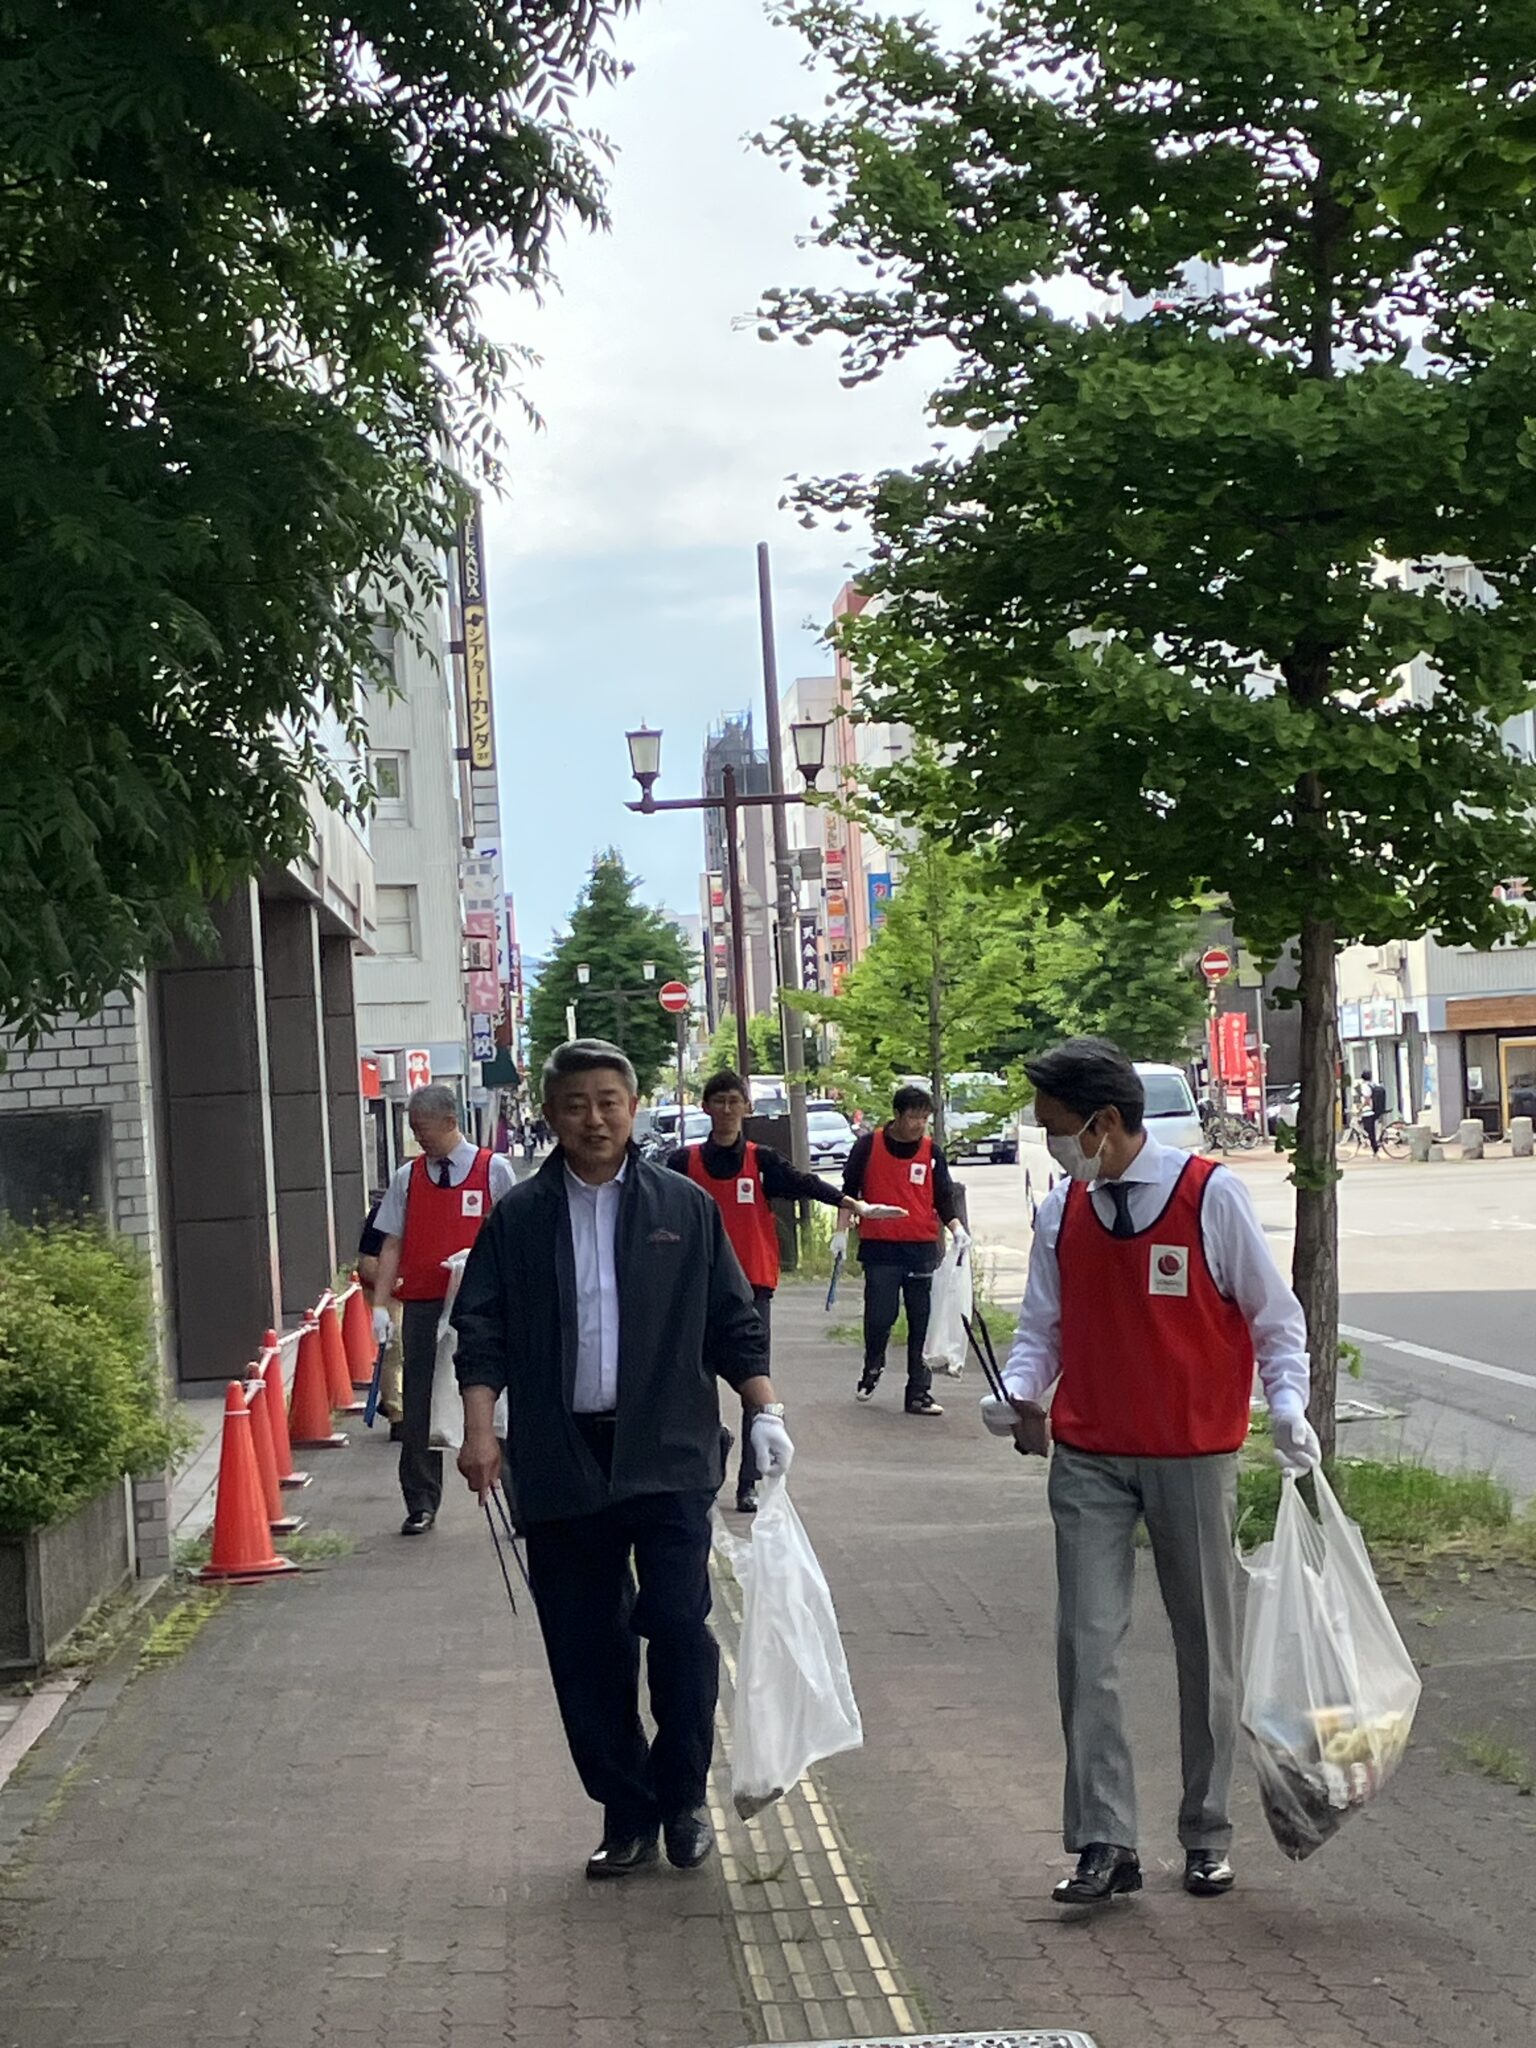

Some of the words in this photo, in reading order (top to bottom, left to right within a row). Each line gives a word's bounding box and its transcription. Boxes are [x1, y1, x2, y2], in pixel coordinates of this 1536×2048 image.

[468, 628, 490, 750] シアター・カンダ
